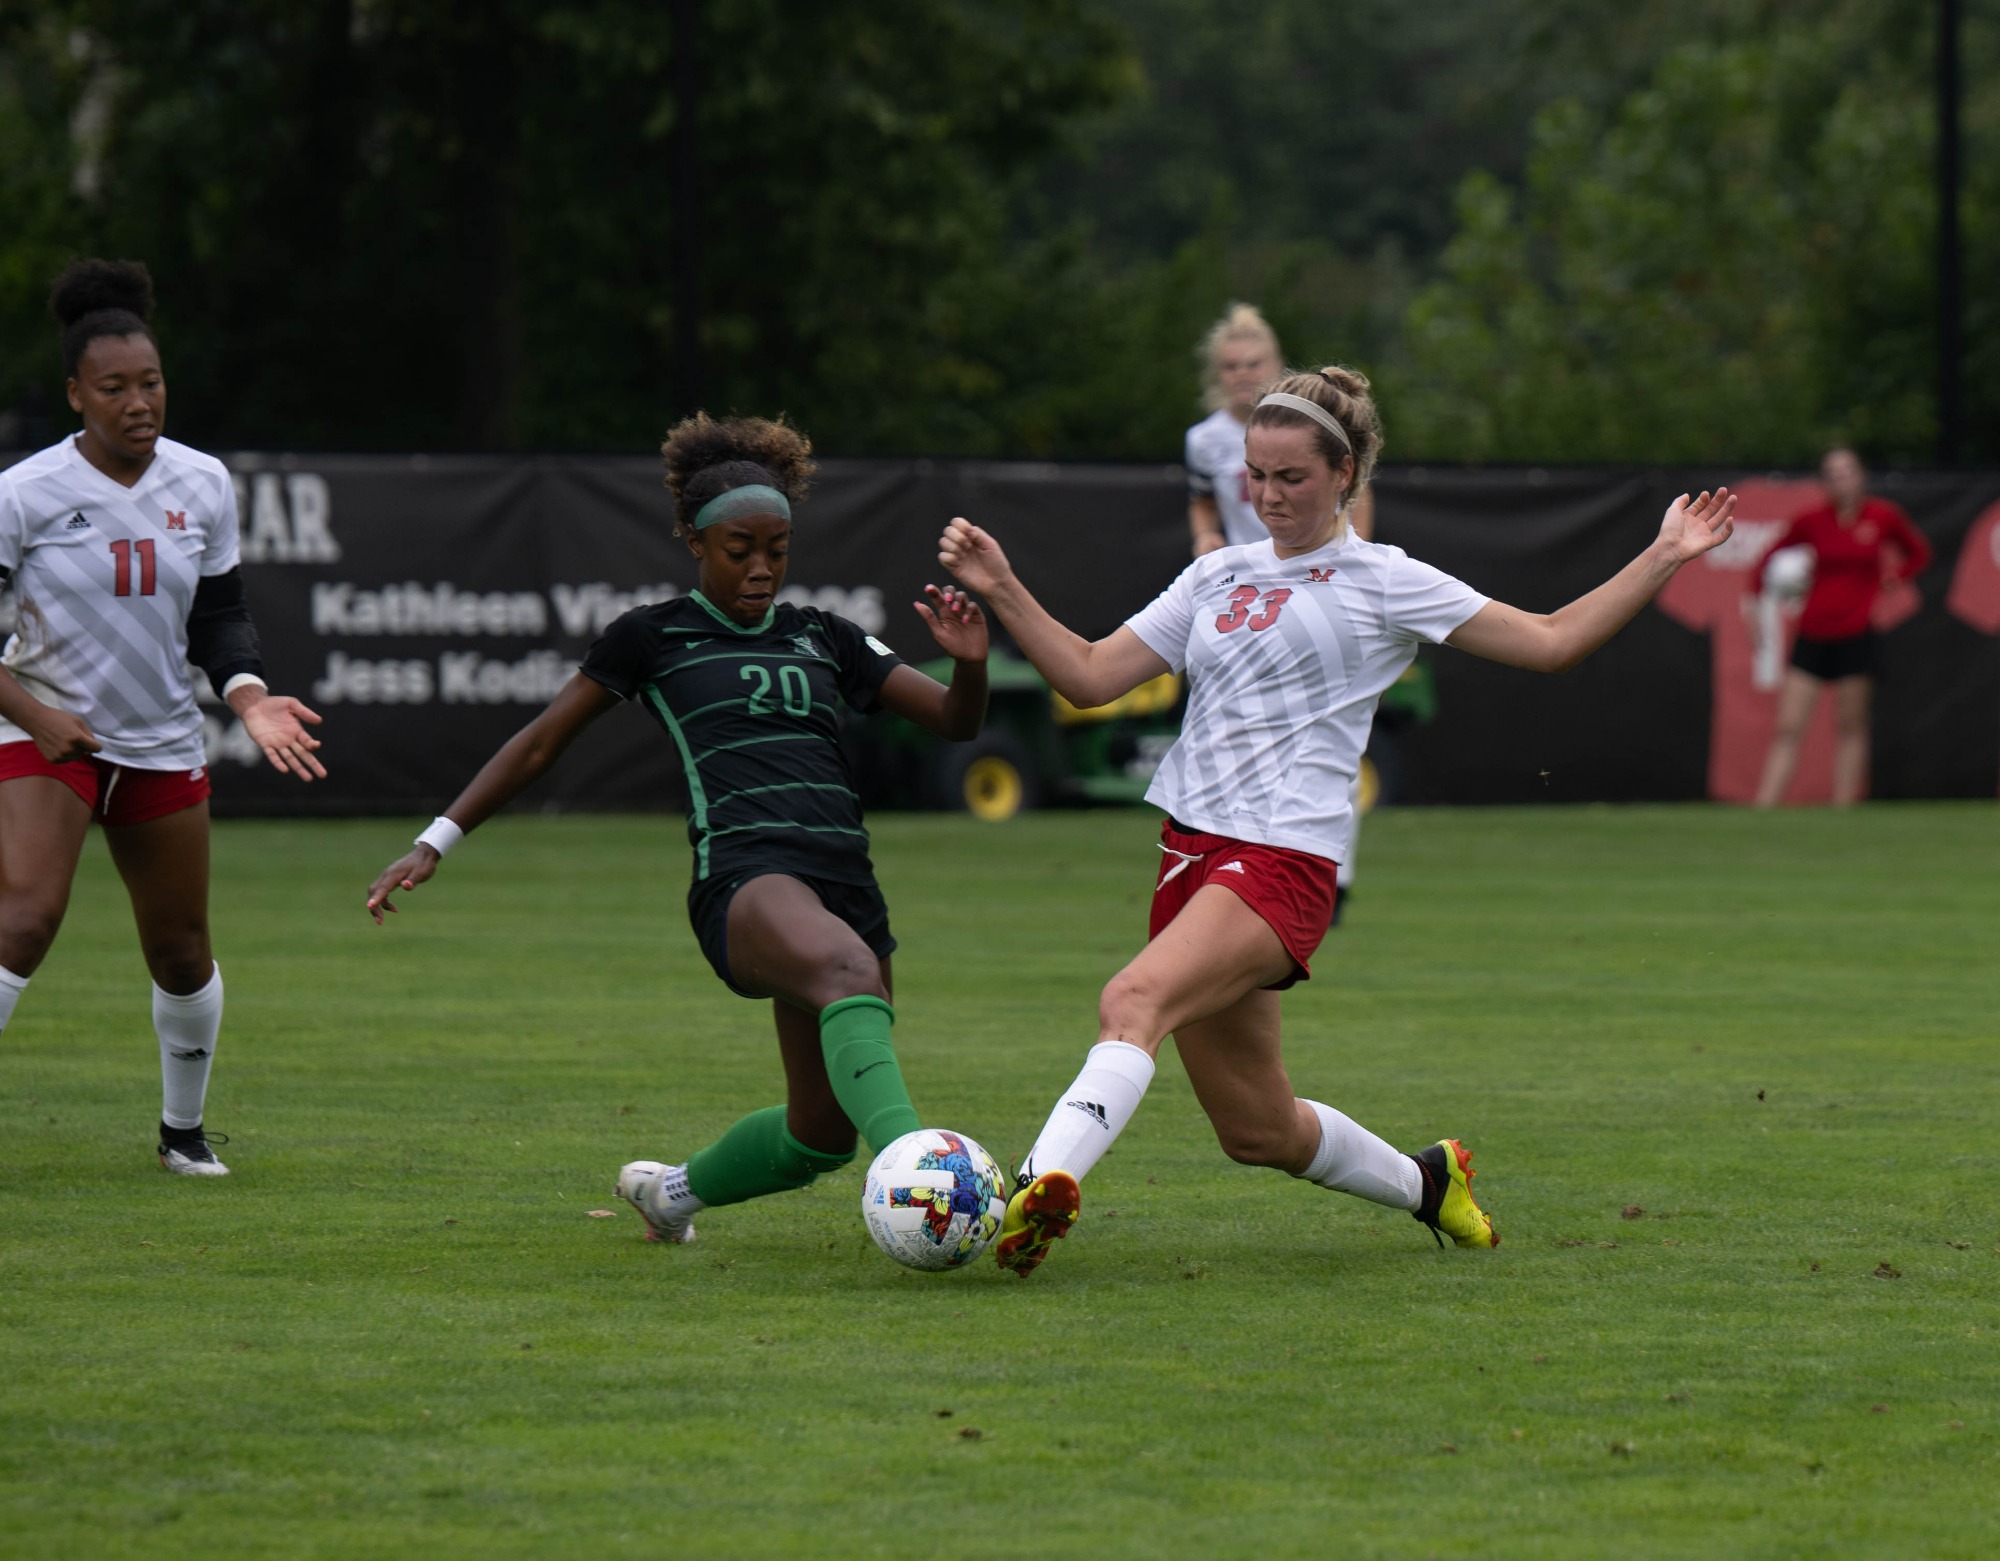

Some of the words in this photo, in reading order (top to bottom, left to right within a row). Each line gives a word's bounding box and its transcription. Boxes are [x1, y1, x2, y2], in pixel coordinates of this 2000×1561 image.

[109, 538, 156, 597] 11
[311, 580, 548, 637] Kathleen
[1215, 585, 1294, 634] 33
[312, 650, 434, 704] Jess
[740, 665, 812, 717] 20
[1067, 1100, 1110, 1131] adidas
